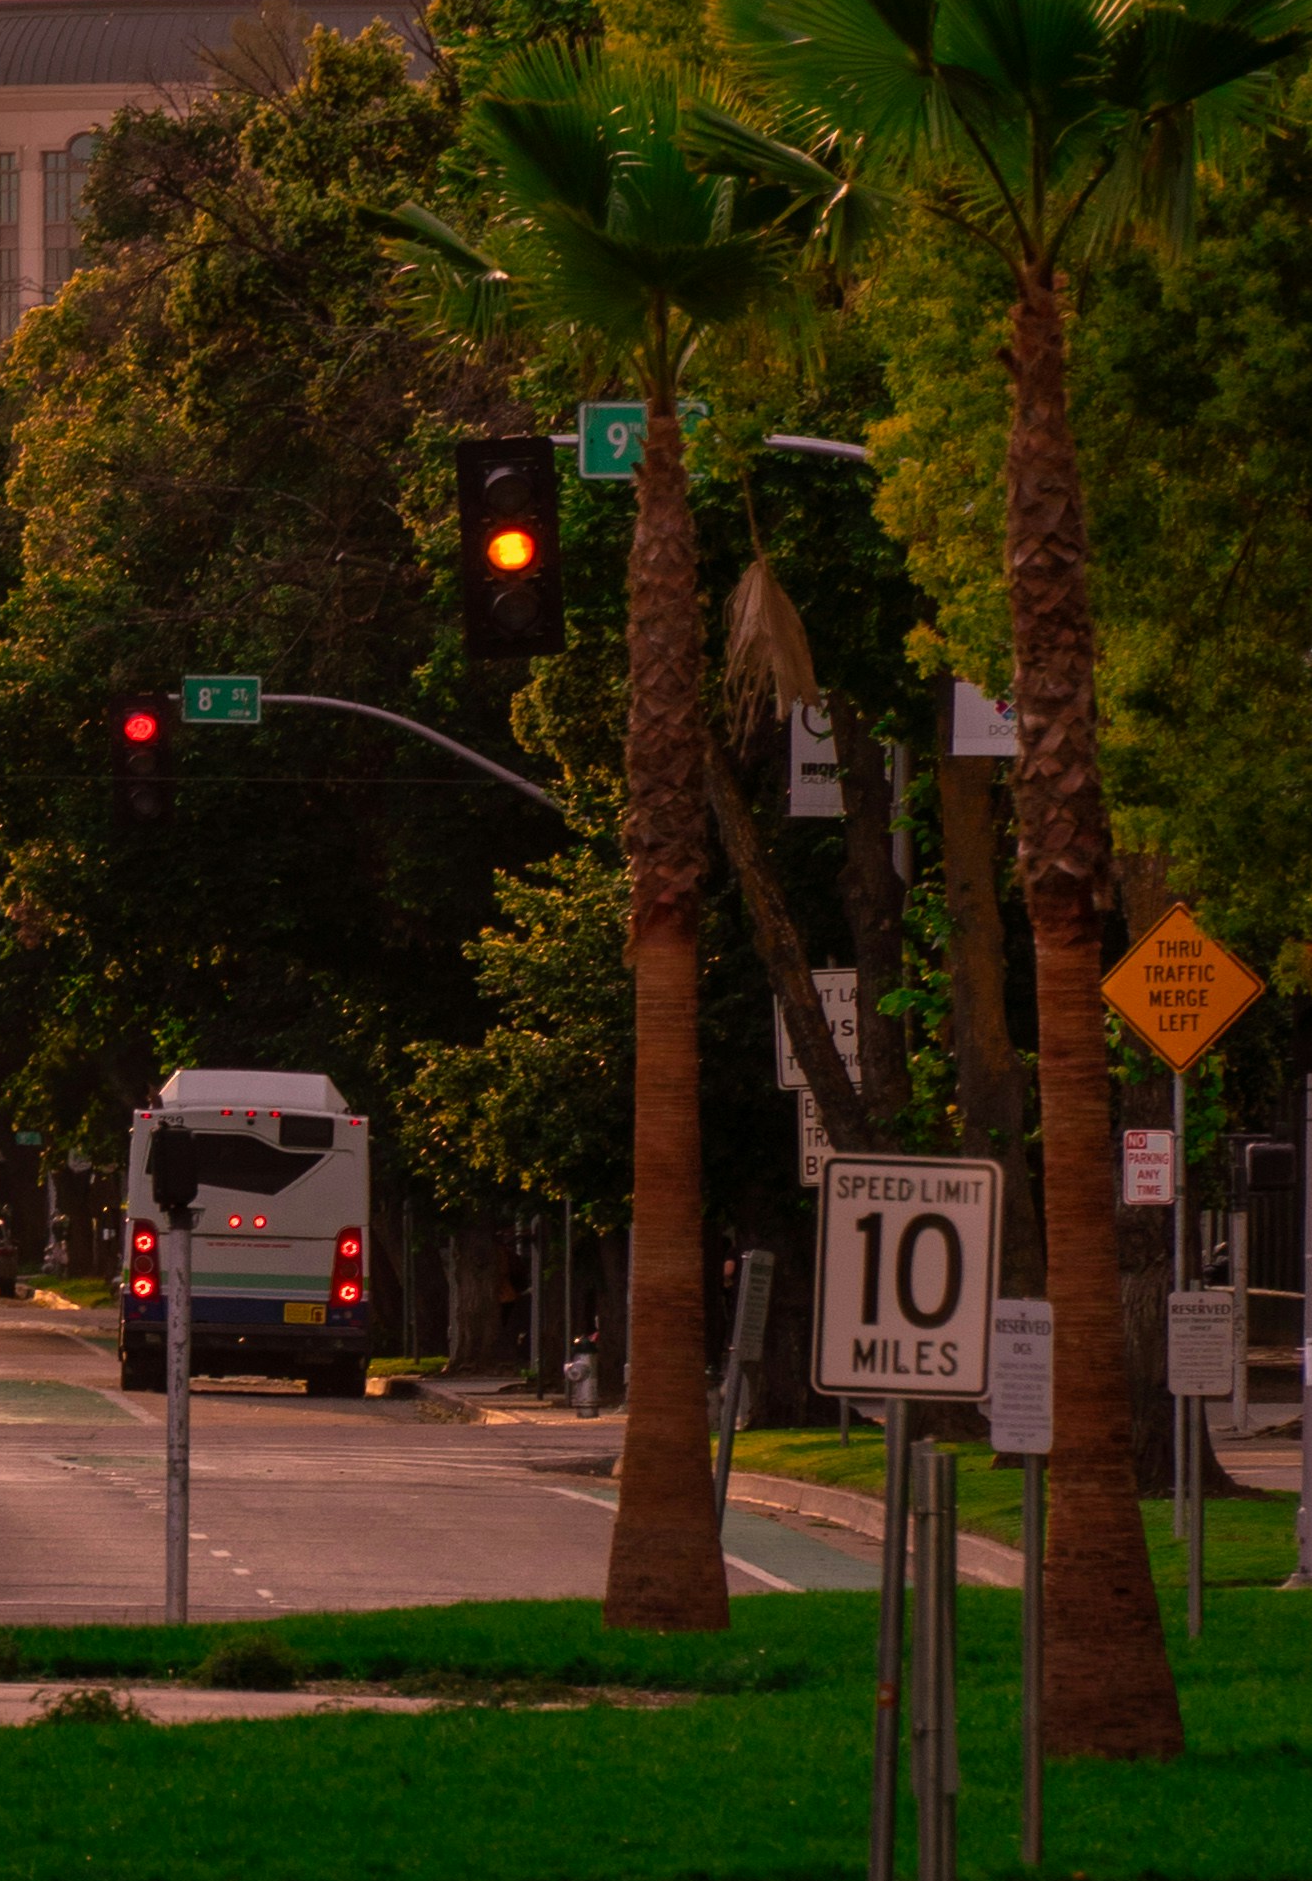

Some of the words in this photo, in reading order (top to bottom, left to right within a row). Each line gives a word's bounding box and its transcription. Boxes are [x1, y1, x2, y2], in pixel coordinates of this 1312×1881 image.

[1156, 940, 1202, 958] THRU
[1144, 965, 1215, 982] TRAFFIC
[1149, 990, 1209, 1007] MERGE
[1159, 1014, 1200, 1032] LEFT
[1128, 1133, 1146, 1148] NO
[1128, 1152, 1169, 1165] PARKING
[1137, 1169, 1160, 1180] ANY
[837, 1176, 914, 1201] SPEED
[920, 1181, 983, 1204] LIMIT
[1137, 1184, 1161, 1196] TIME
[856, 1212, 963, 1329] 10
[1171, 1304, 1231, 1315] RESERVED
[995, 1319, 1052, 1336] RESERVED
[852, 1338, 959, 1377] MILES
